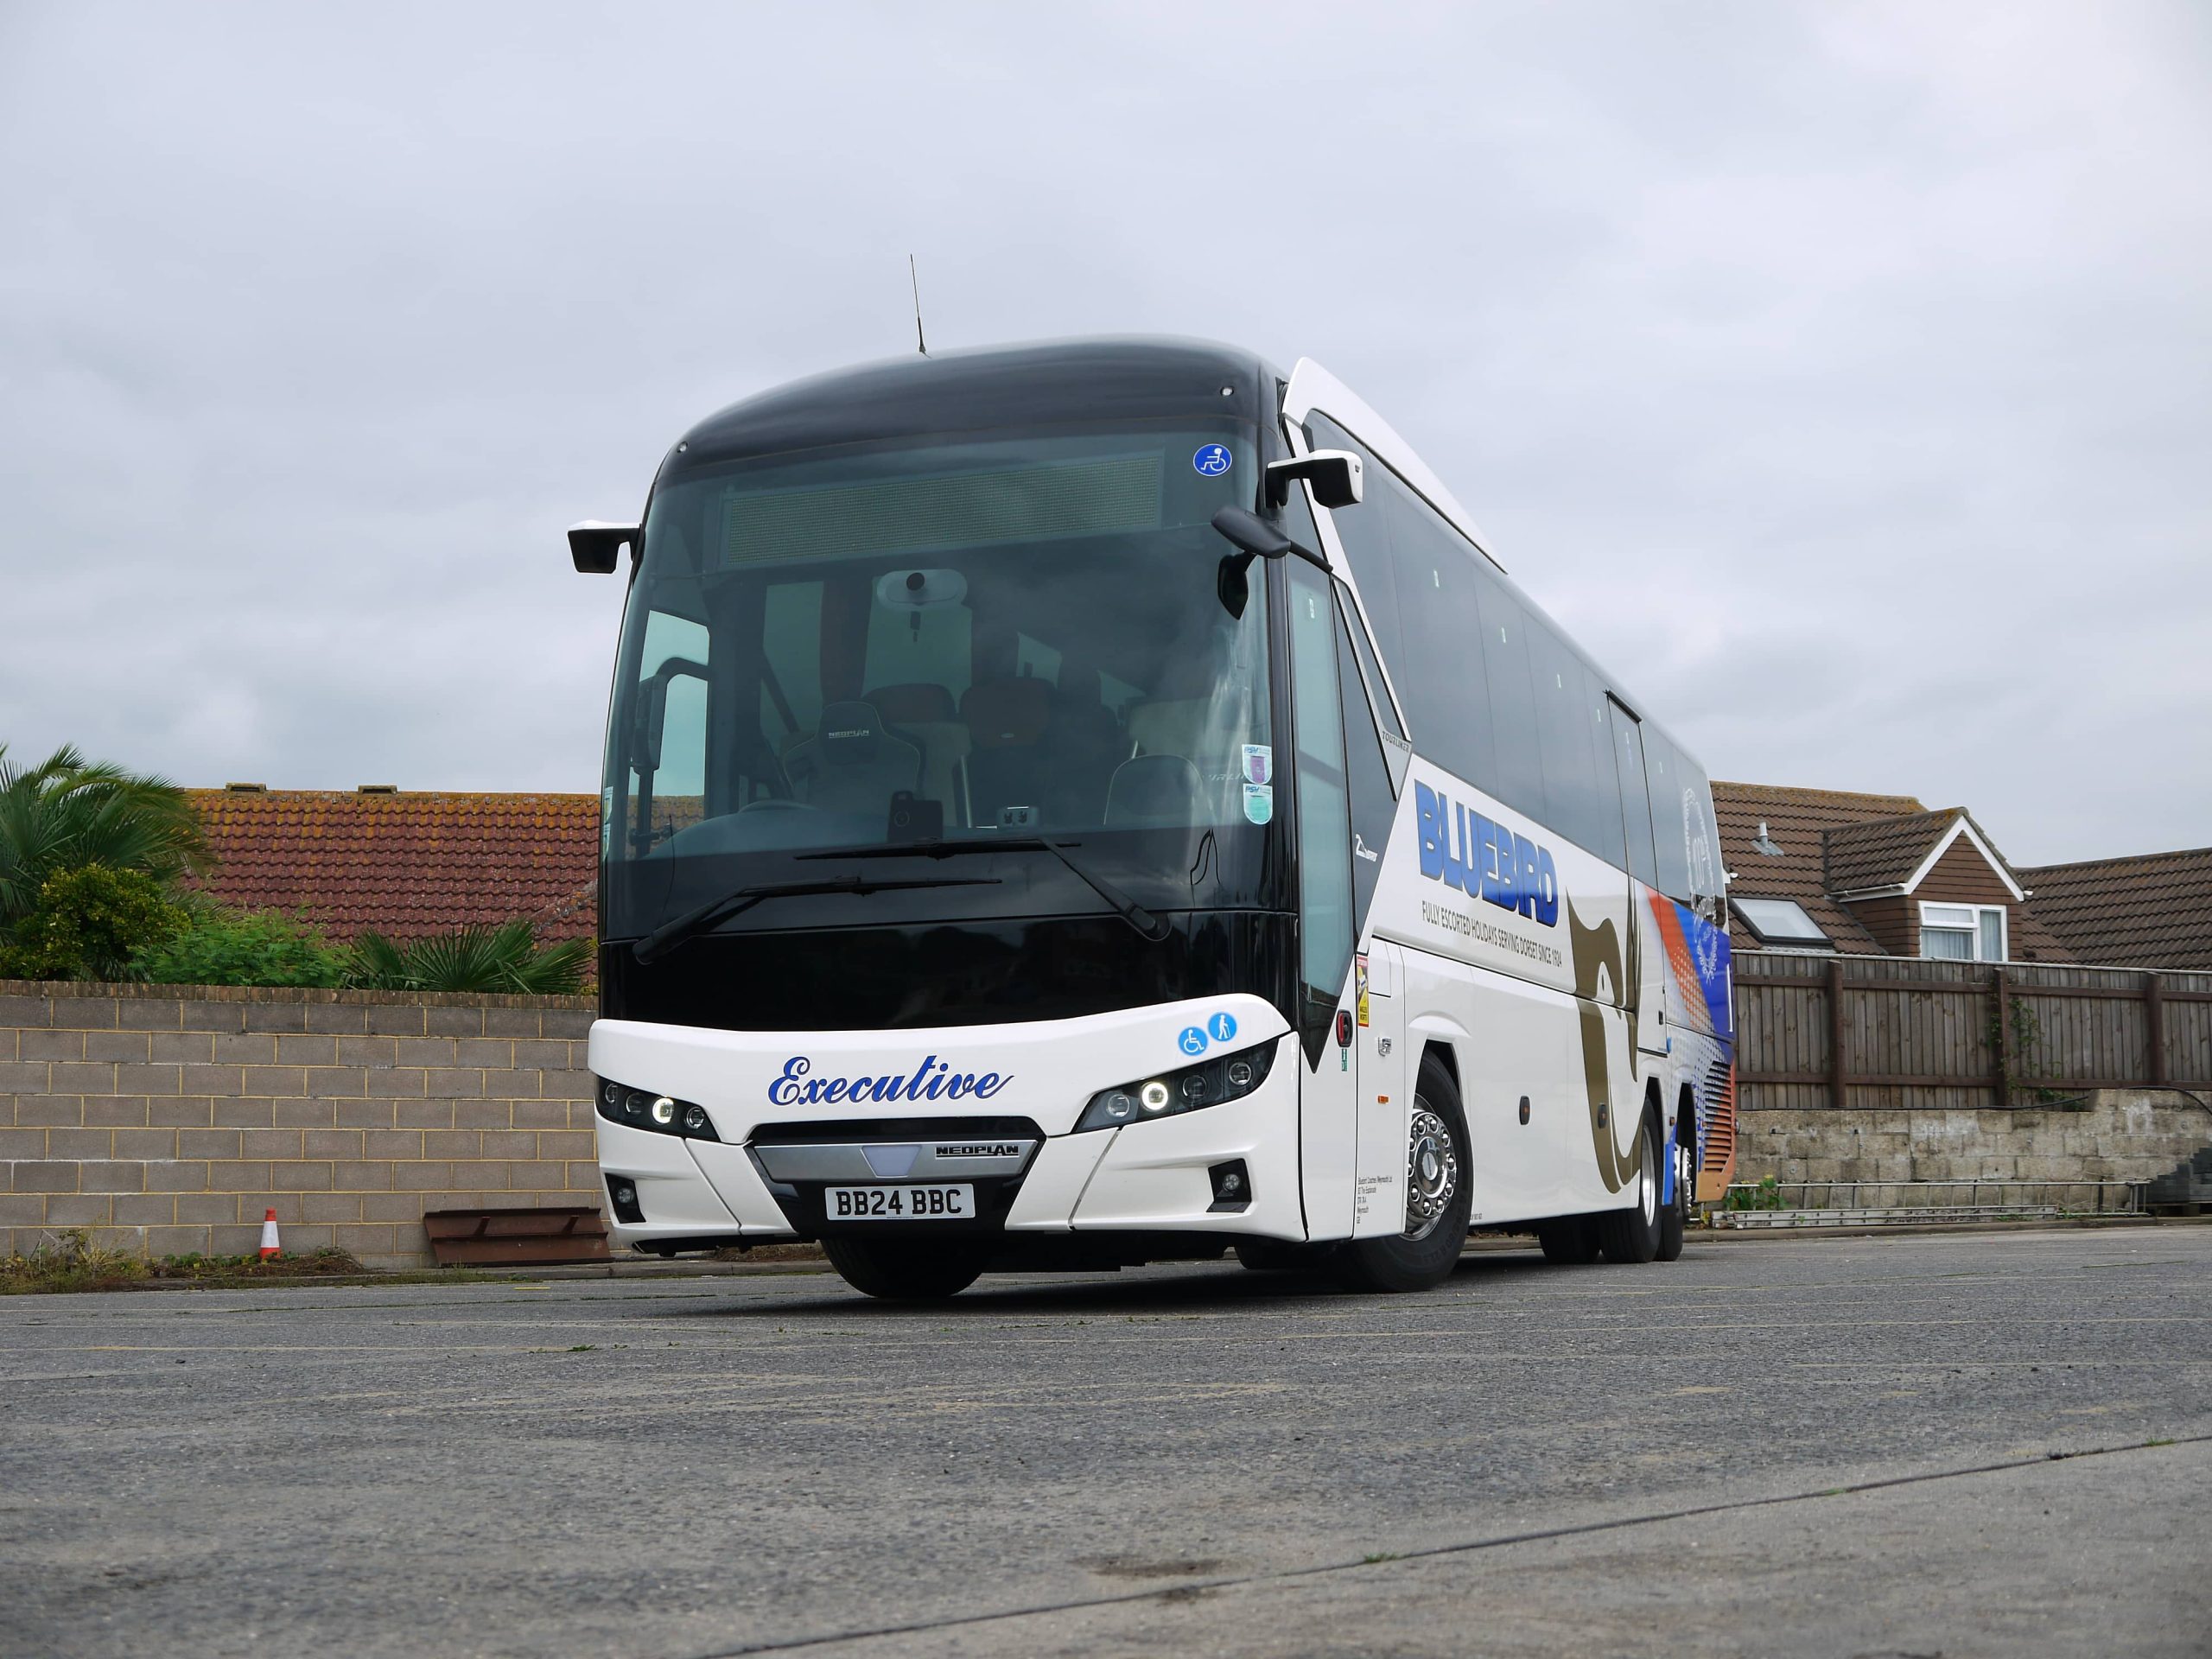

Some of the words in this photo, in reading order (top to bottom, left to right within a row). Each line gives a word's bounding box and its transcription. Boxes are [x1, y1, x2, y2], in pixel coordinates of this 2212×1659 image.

[1382, 730, 1410, 753] TOURLINER
[1414, 779, 1559, 927] BLUEBIRD
[1421, 900, 1440, 925] FULLY
[1440, 907, 1471, 936] ESCORTED
[1471, 918, 1497, 946] HOLIDAYS
[1497, 928, 1520, 954] SERVING
[1520, 936, 1538, 960] DORSET
[1538, 943, 1552, 965] SINCE
[768, 1055, 1014, 1106] Executive
[936, 1145, 1019, 1157] NEOPLAN
[836, 1190, 903, 1215] BB24
[910, 1189, 963, 1214] BBC
